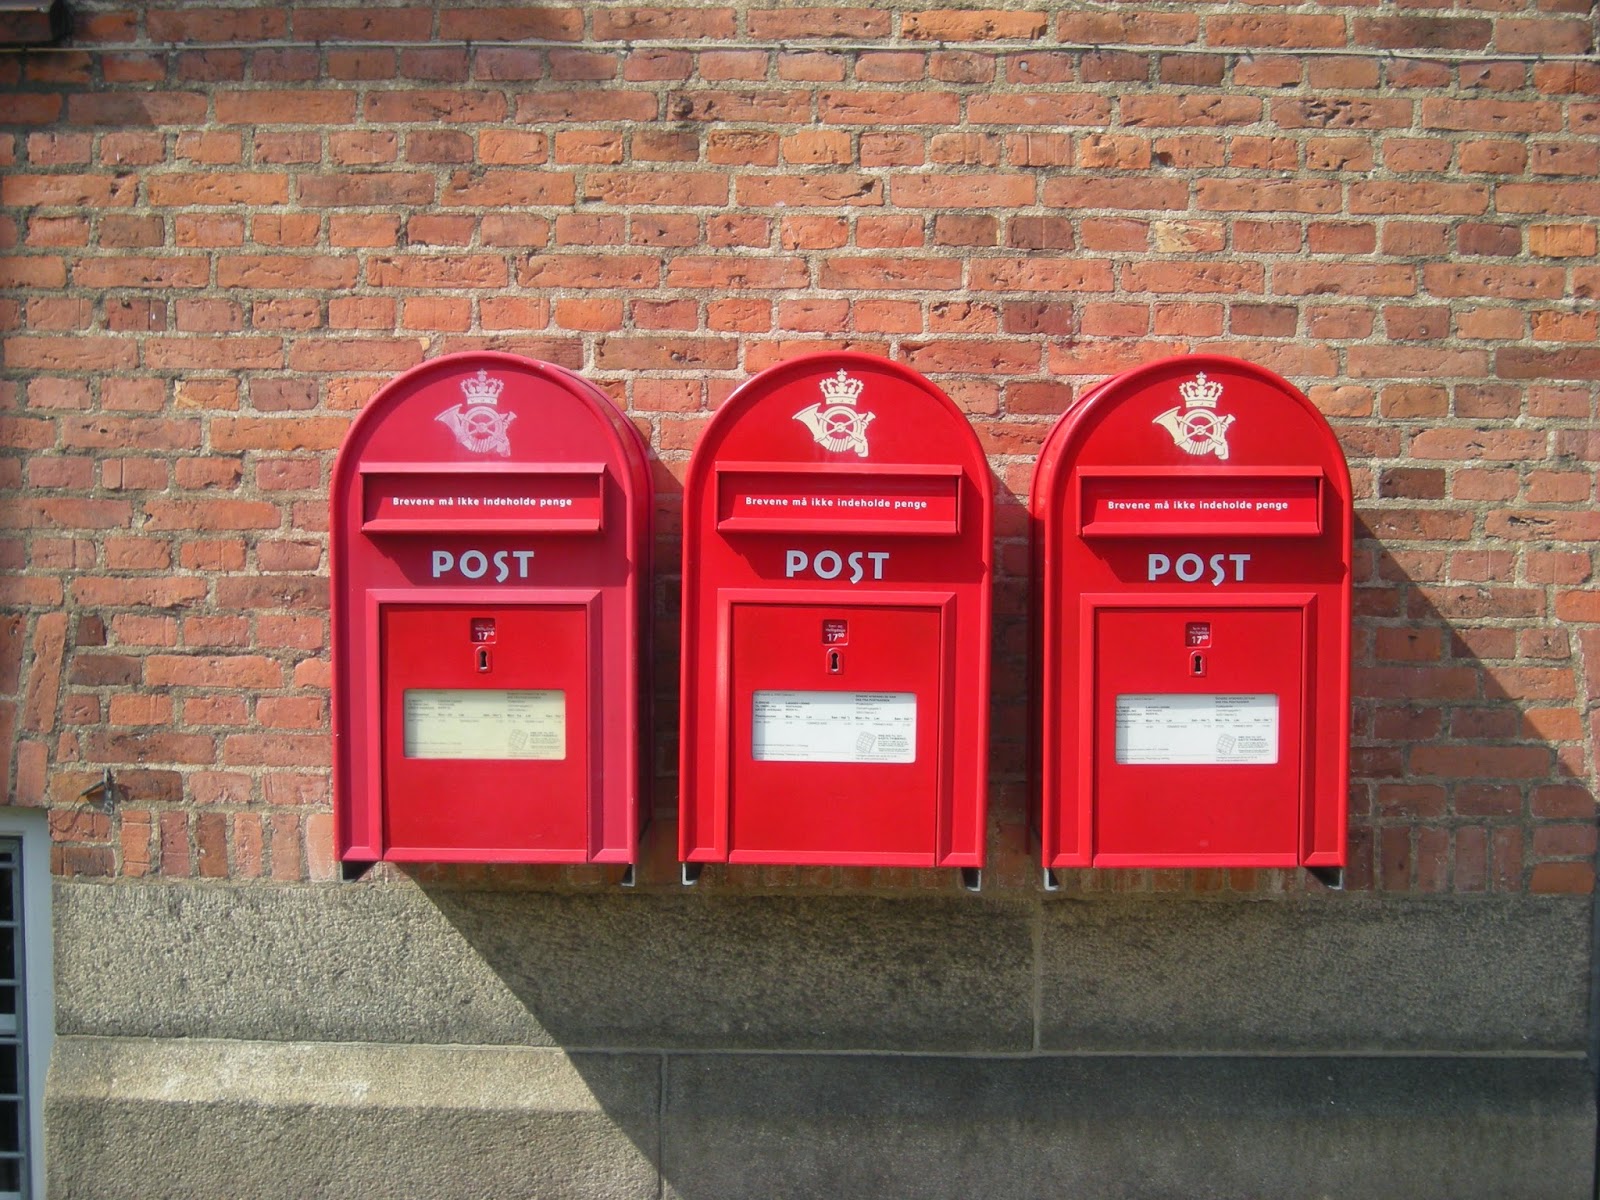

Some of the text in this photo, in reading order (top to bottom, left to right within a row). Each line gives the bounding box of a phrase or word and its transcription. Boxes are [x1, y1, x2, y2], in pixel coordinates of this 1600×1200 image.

[393, 496, 573, 508] Brevene må ikke indeholde penge
[745, 496, 927, 510] Brevene må ikke indeholde penge
[1108, 500, 1288, 511] Brevene må ikke indeholde penge
[432, 550, 535, 583] POST
[786, 550, 890, 584] POST
[1148, 553, 1251, 586] POST
